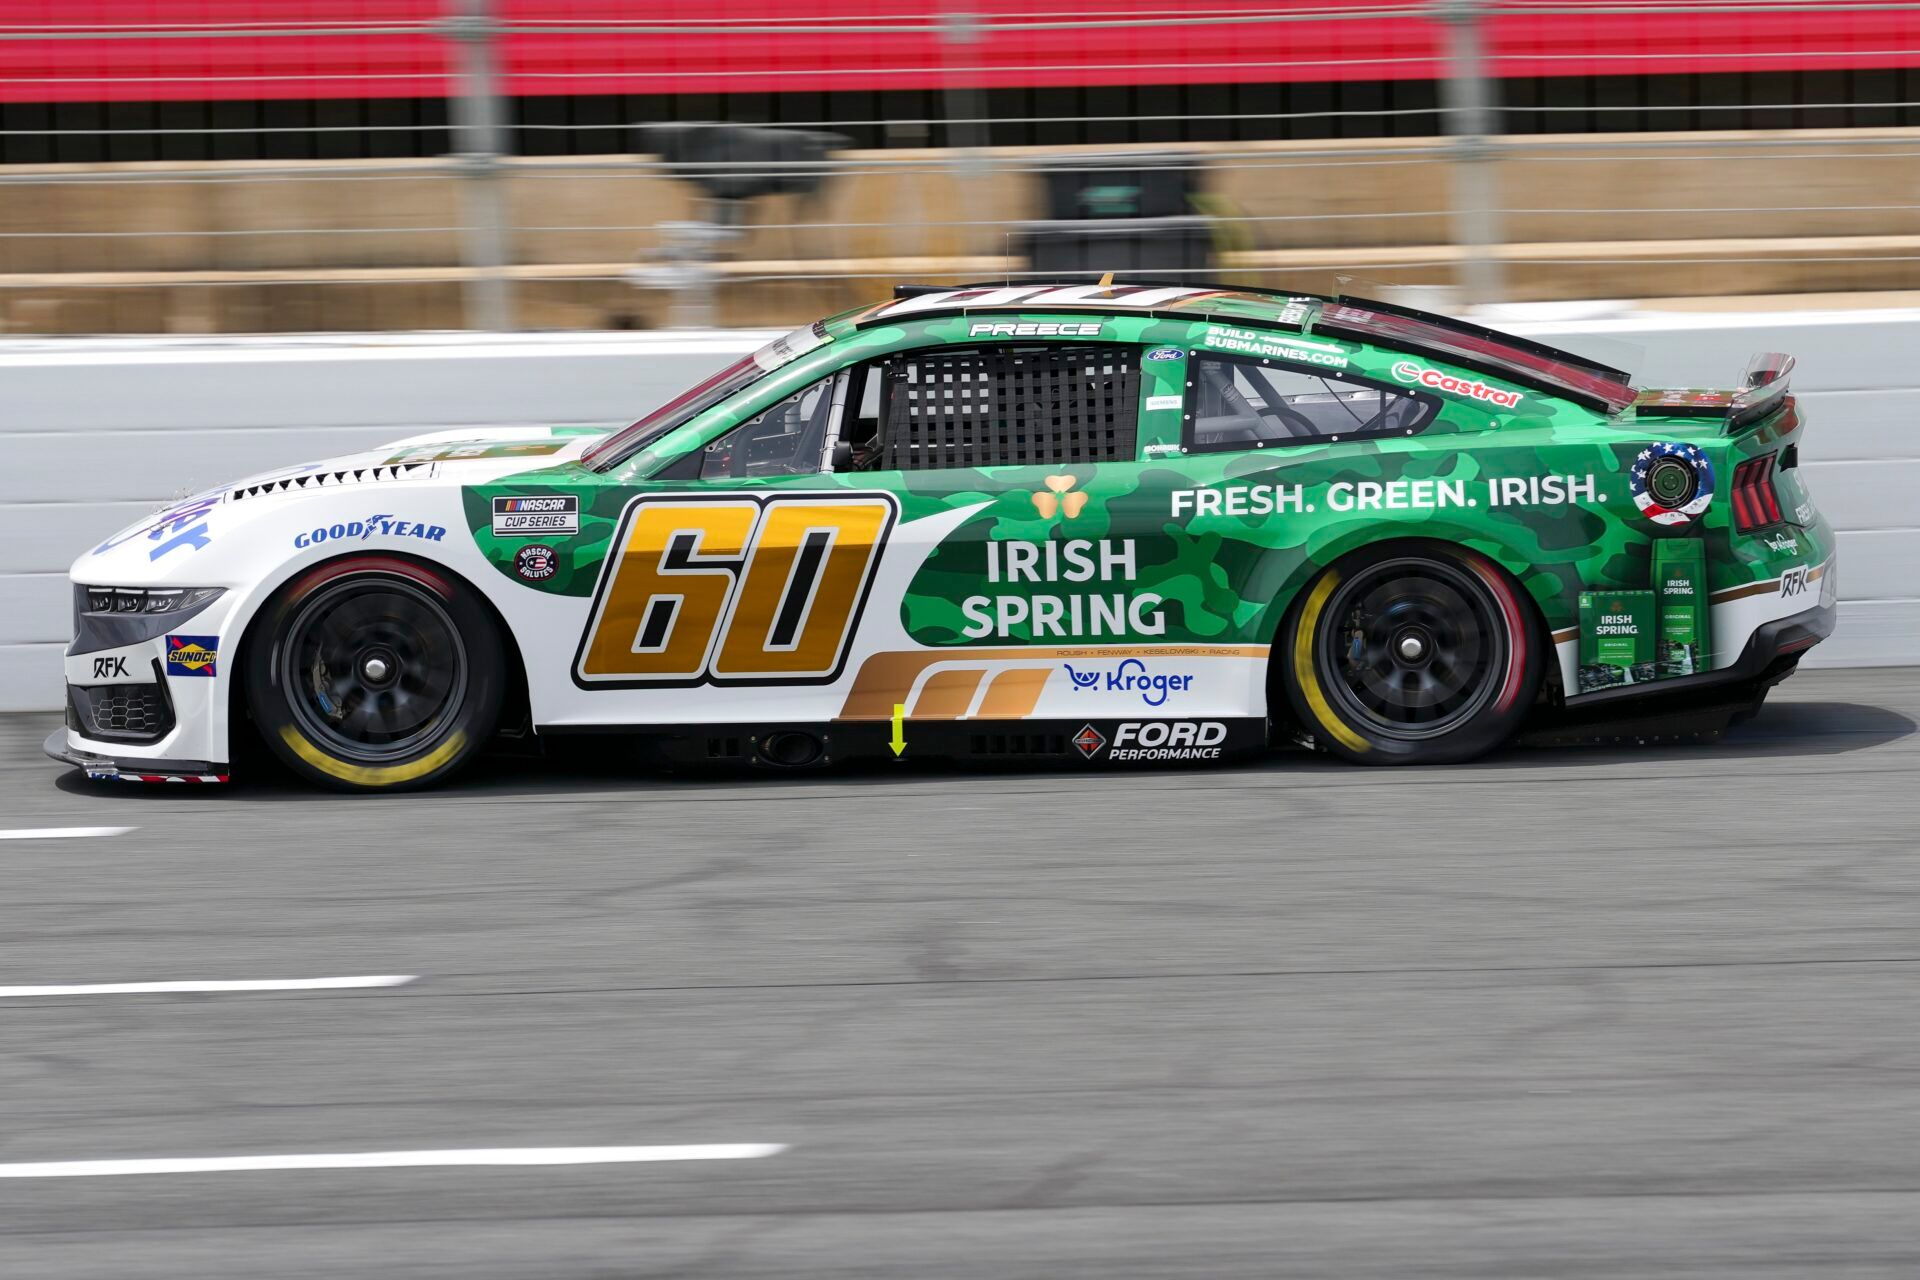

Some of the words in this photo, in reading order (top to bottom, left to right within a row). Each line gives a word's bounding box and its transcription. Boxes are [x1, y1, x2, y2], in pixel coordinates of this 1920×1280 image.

[969, 322, 1102, 337] PREECE
[1207, 327, 1256, 340] BUILD
[1153, 350, 1177, 359] Ford
[1204, 336, 1348, 368] SUBMARINES.COM
[1420, 370, 1523, 408] Castrol
[1171, 484, 1315, 517] FRESH.
[1327, 479, 1477, 511] GREEN.
[1488, 474, 1608, 506] IRISH.
[520, 499, 566, 510] NASCAR
[504, 516, 527, 527] CUP
[528, 515, 567, 527] SERIES
[294, 514, 447, 549] GOODYEAR
[520, 548, 552, 560] NASCAR
[986, 539, 1136, 582] IRISH
[519, 567, 553, 578] SALUTES
[575, 495, 897, 686] 60
[1663, 587, 1693, 595] SPRING
[1781, 569, 1807, 598] RFK
[961, 593, 1166, 638] SPRING
[1601, 615, 1632, 624] IRISH
[1596, 625, 1638, 635] SPRING
[170, 651, 216, 662] SUNOCO
[93, 656, 130, 678] RFK
[1106, 658, 1193, 706] Kroger
[1112, 722, 1227, 747] FORD
[1109, 747, 1221, 760] PERFORMANCE
